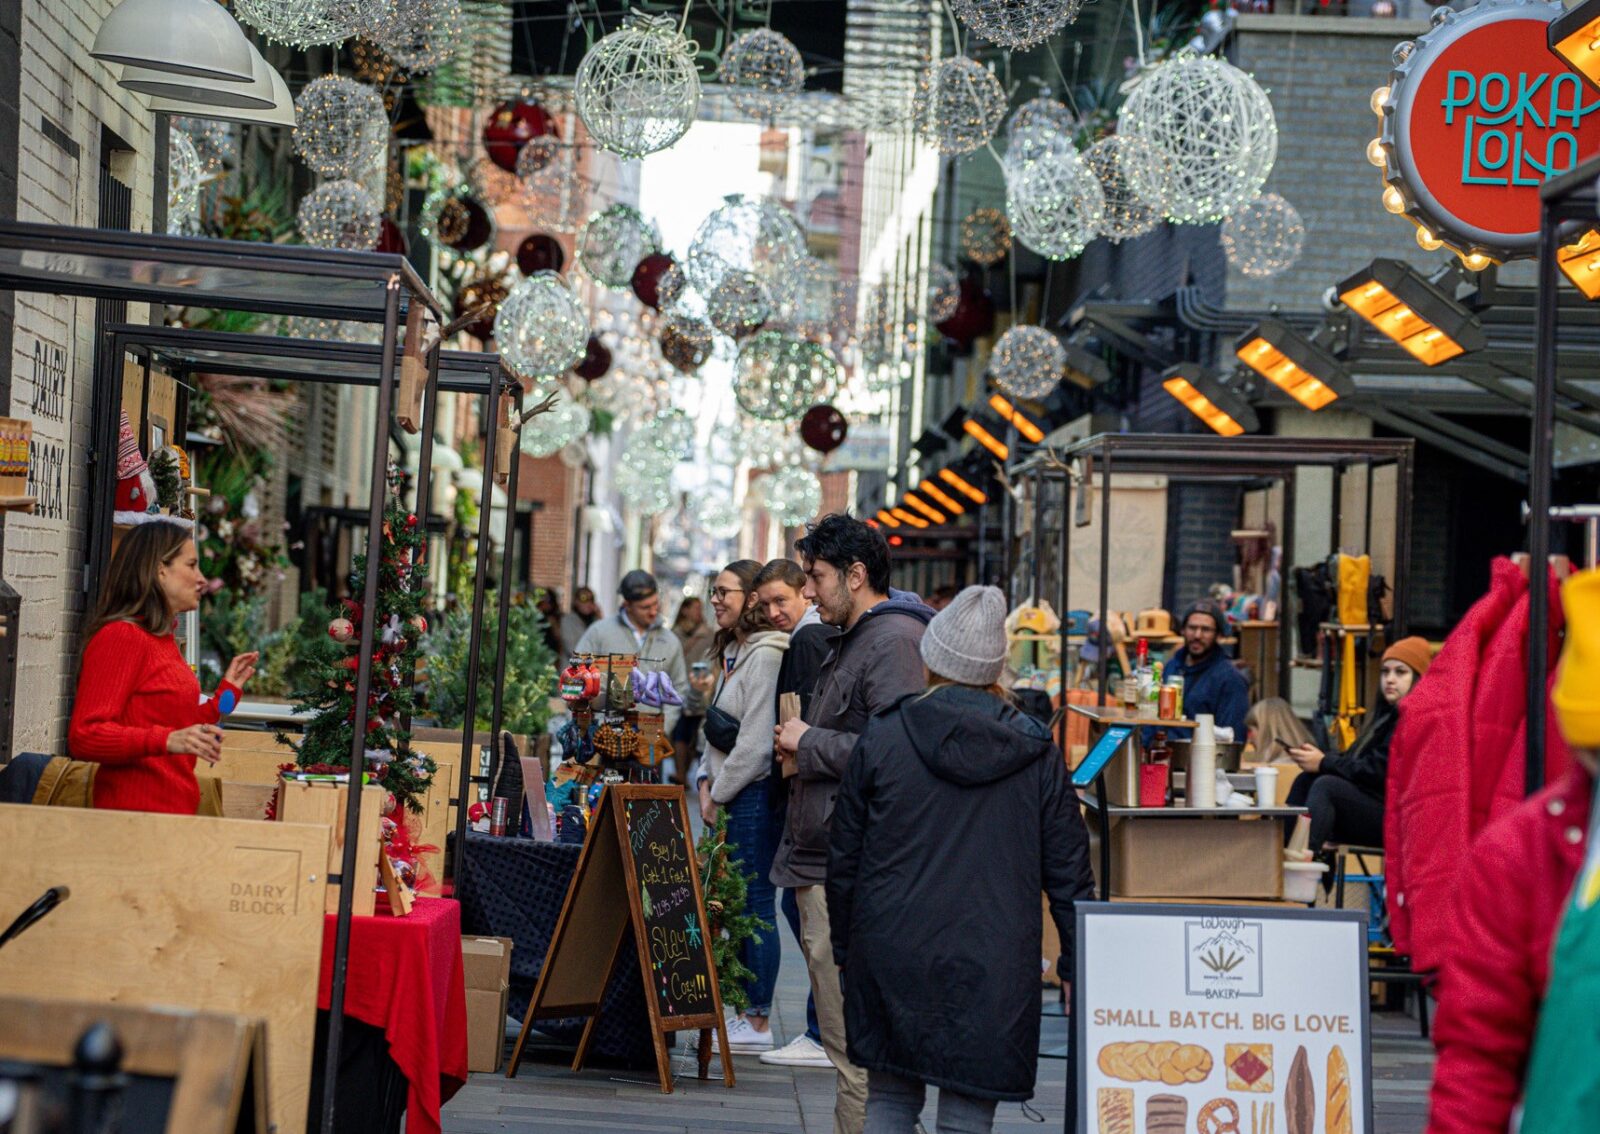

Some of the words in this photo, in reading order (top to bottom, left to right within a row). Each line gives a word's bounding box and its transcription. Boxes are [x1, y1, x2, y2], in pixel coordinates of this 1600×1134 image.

[1441, 70, 1600, 129] POKA
[1461, 115, 1579, 186] LOLA
[31, 339, 68, 424] DAIRY
[28, 440, 65, 520] BLOCK
[649, 841, 670, 865] Buy
[671, 838, 685, 861] 2
[642, 863, 661, 884] Get
[661, 865, 669, 885] 1
[231, 882, 288, 898] DAIRY
[229, 899, 286, 916] BLOCK
[652, 926, 691, 969] Stay
[671, 972, 707, 1004] Cozy!!
[1205, 988, 1240, 999] BAKERY
[1093, 1009, 1161, 1028] SMALL
[1169, 1011, 1244, 1030] BATCH.
[1252, 1013, 1286, 1032] BIG
[1293, 1014, 1355, 1034] LOVE.
